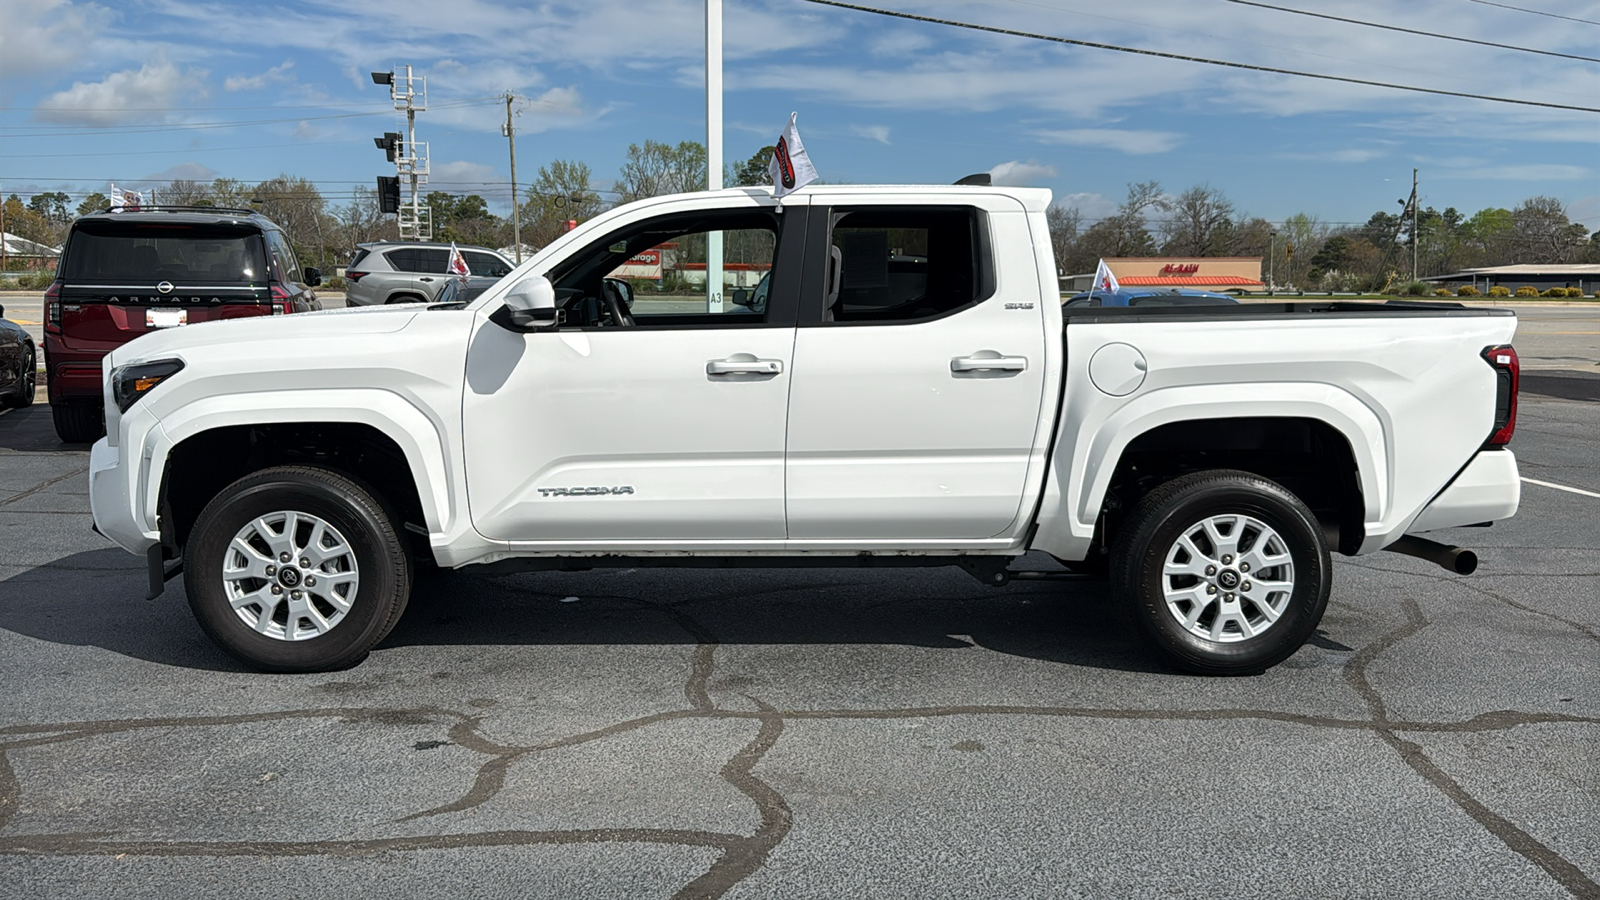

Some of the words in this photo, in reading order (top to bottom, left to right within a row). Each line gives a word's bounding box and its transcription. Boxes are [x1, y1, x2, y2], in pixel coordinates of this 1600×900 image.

[629, 254, 657, 263] orage
[711, 292, 722, 304] A3
[537, 486, 635, 497] TACOMA
